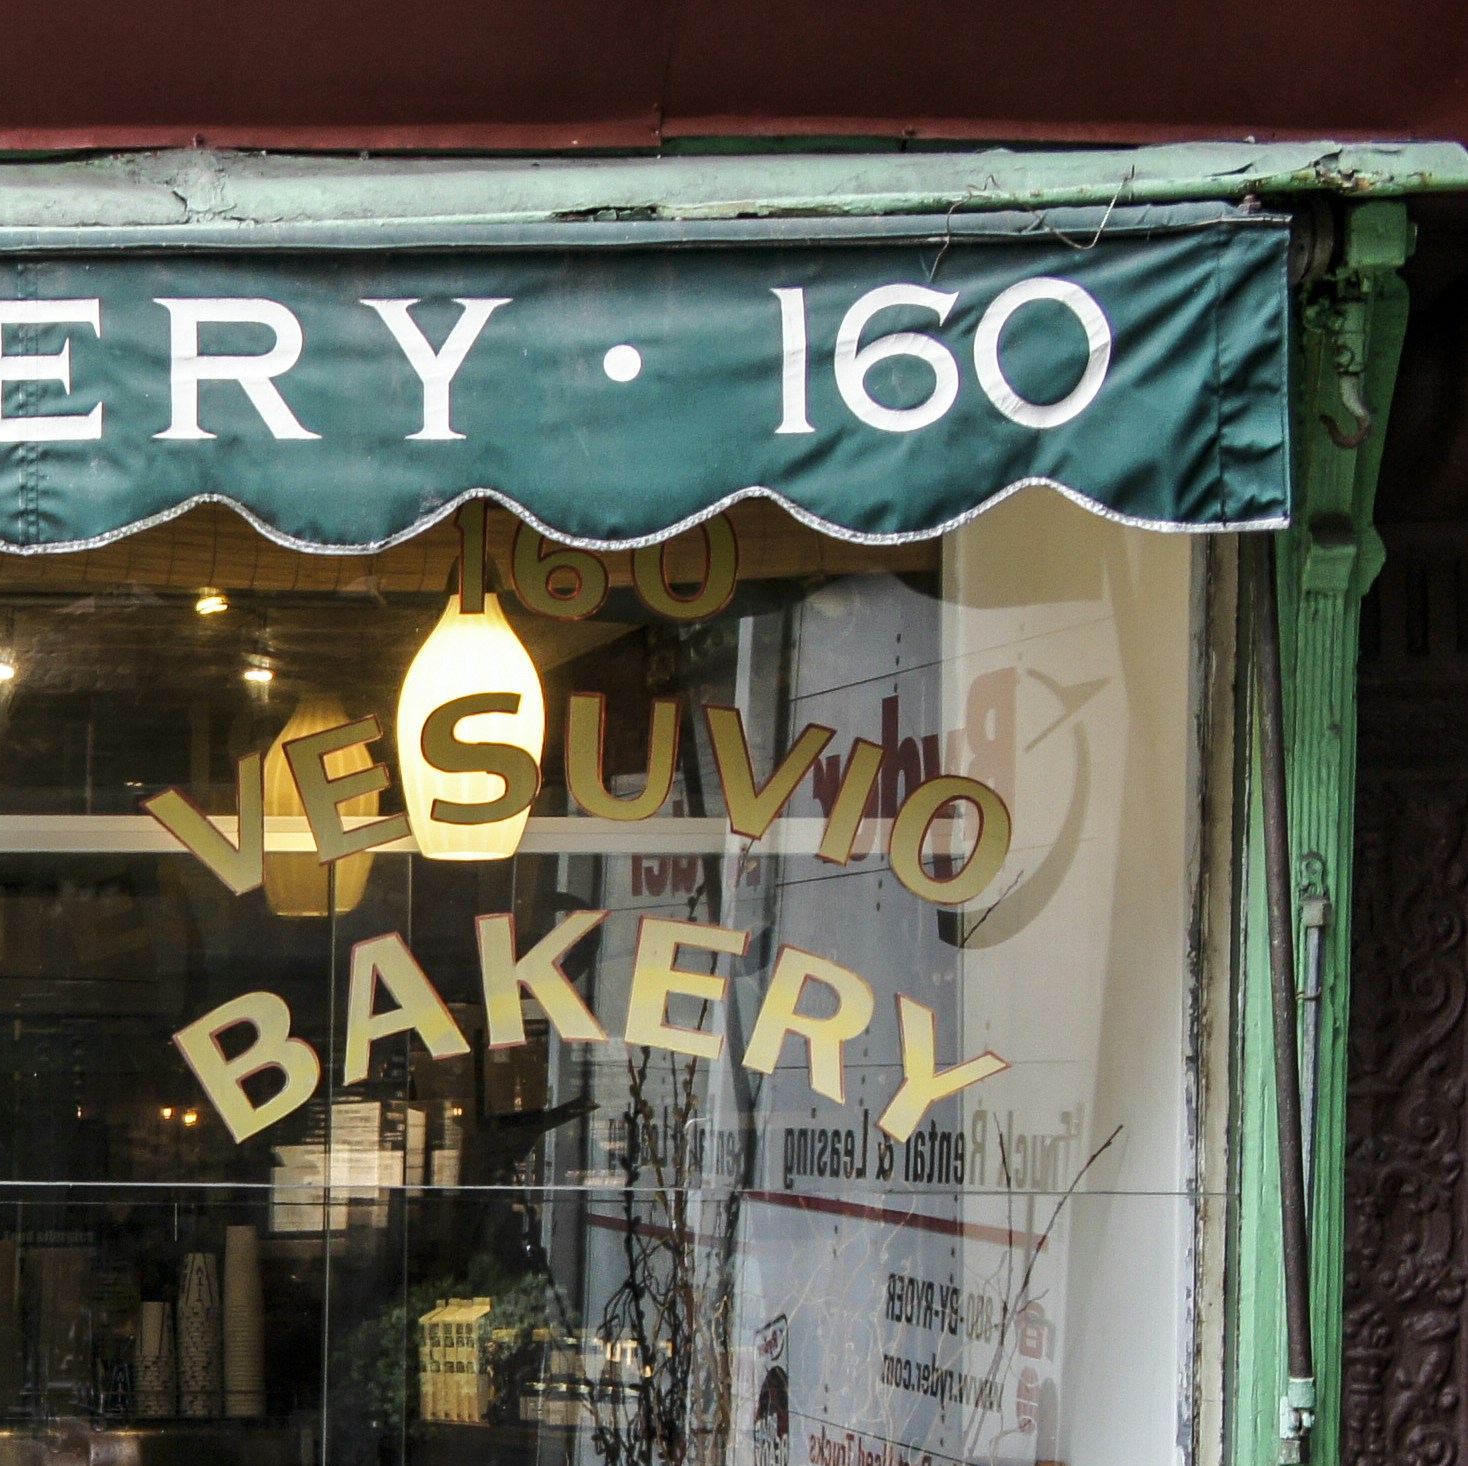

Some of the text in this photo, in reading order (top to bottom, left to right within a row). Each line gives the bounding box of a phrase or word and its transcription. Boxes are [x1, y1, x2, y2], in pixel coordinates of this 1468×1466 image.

[769, 276, 1112, 434] 160
[455, 495, 740, 619] 160
[139, 690, 1012, 905] VESUVIO
[172, 909, 1012, 1144] BAKERY
